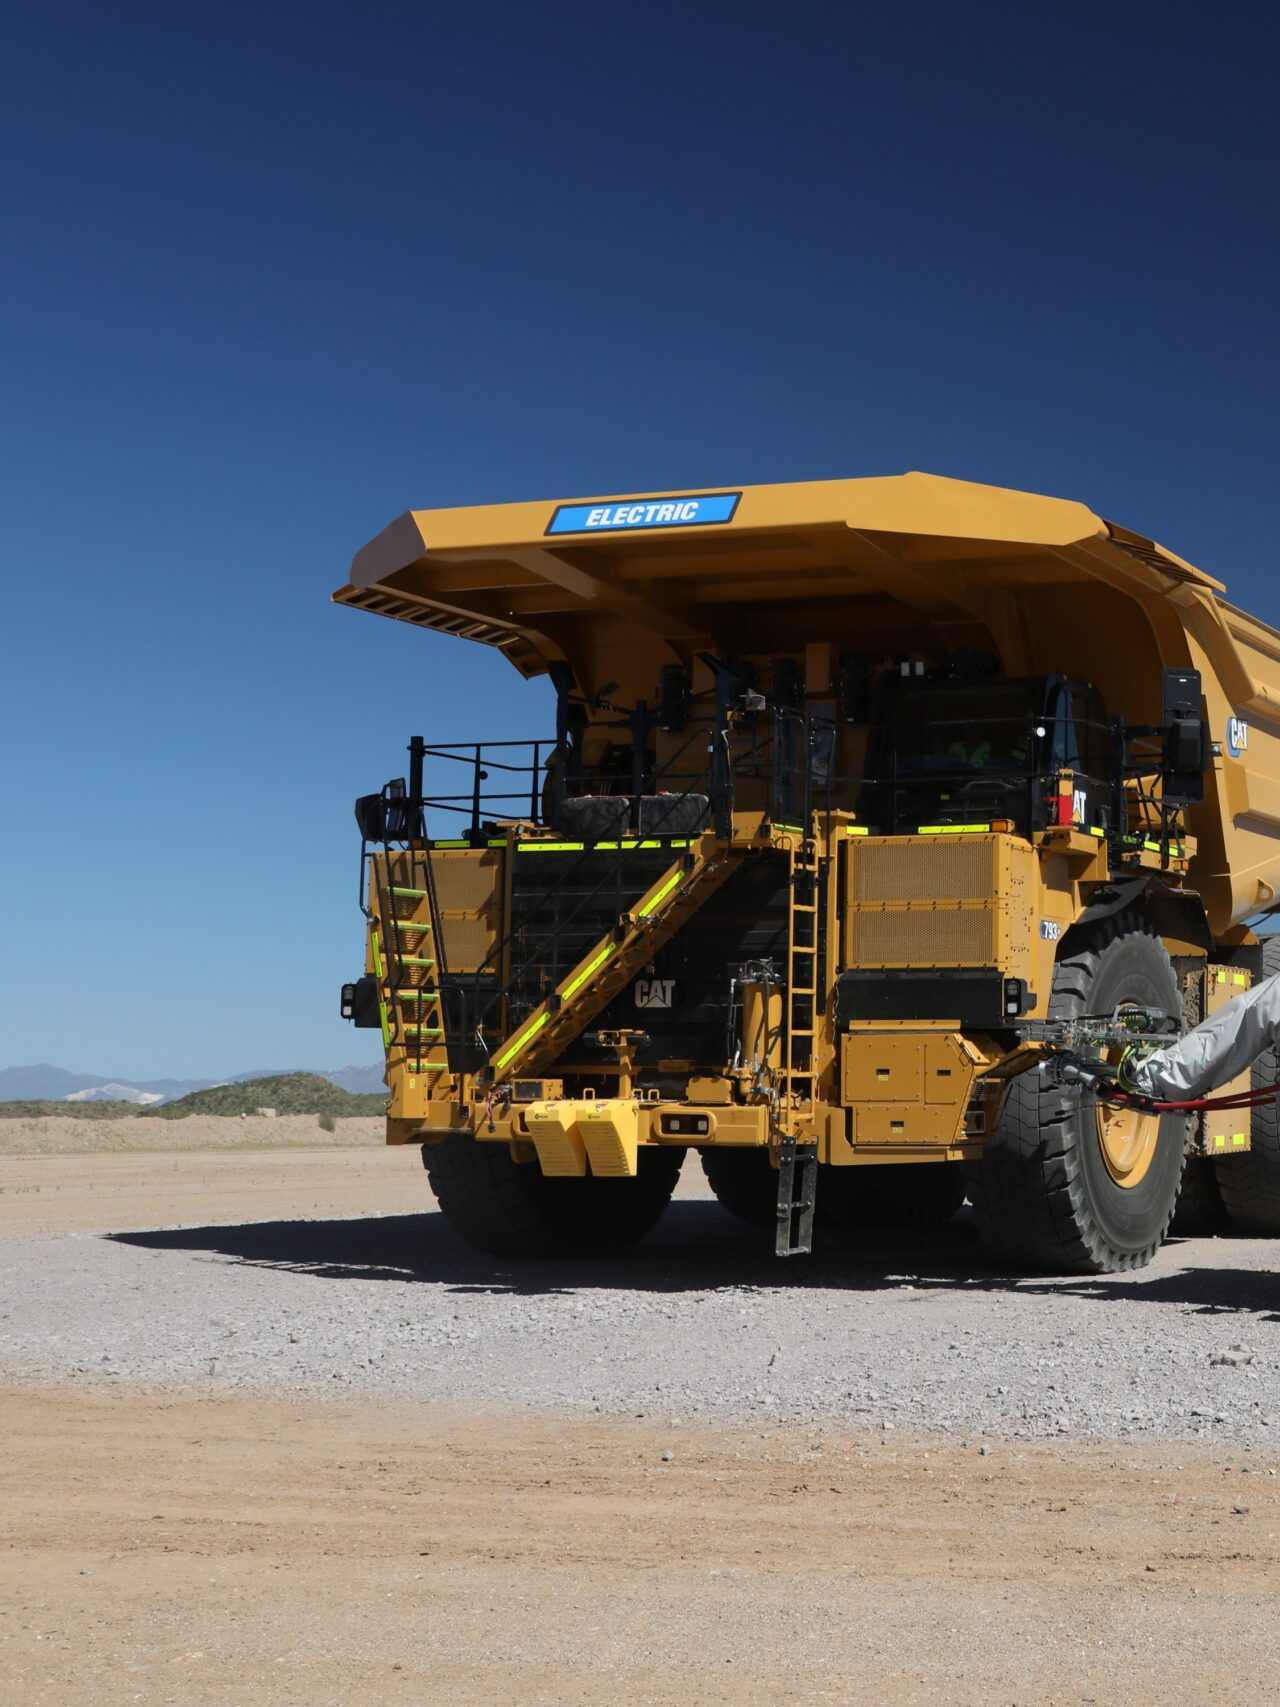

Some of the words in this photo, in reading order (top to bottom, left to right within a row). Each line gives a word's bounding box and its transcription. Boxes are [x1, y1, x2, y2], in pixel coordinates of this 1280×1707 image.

[585, 502, 699, 527] ELECTRIC
[1231, 718, 1248, 749] CAT
[1072, 789, 1087, 825] AT
[635, 980, 676, 1008] CAT
